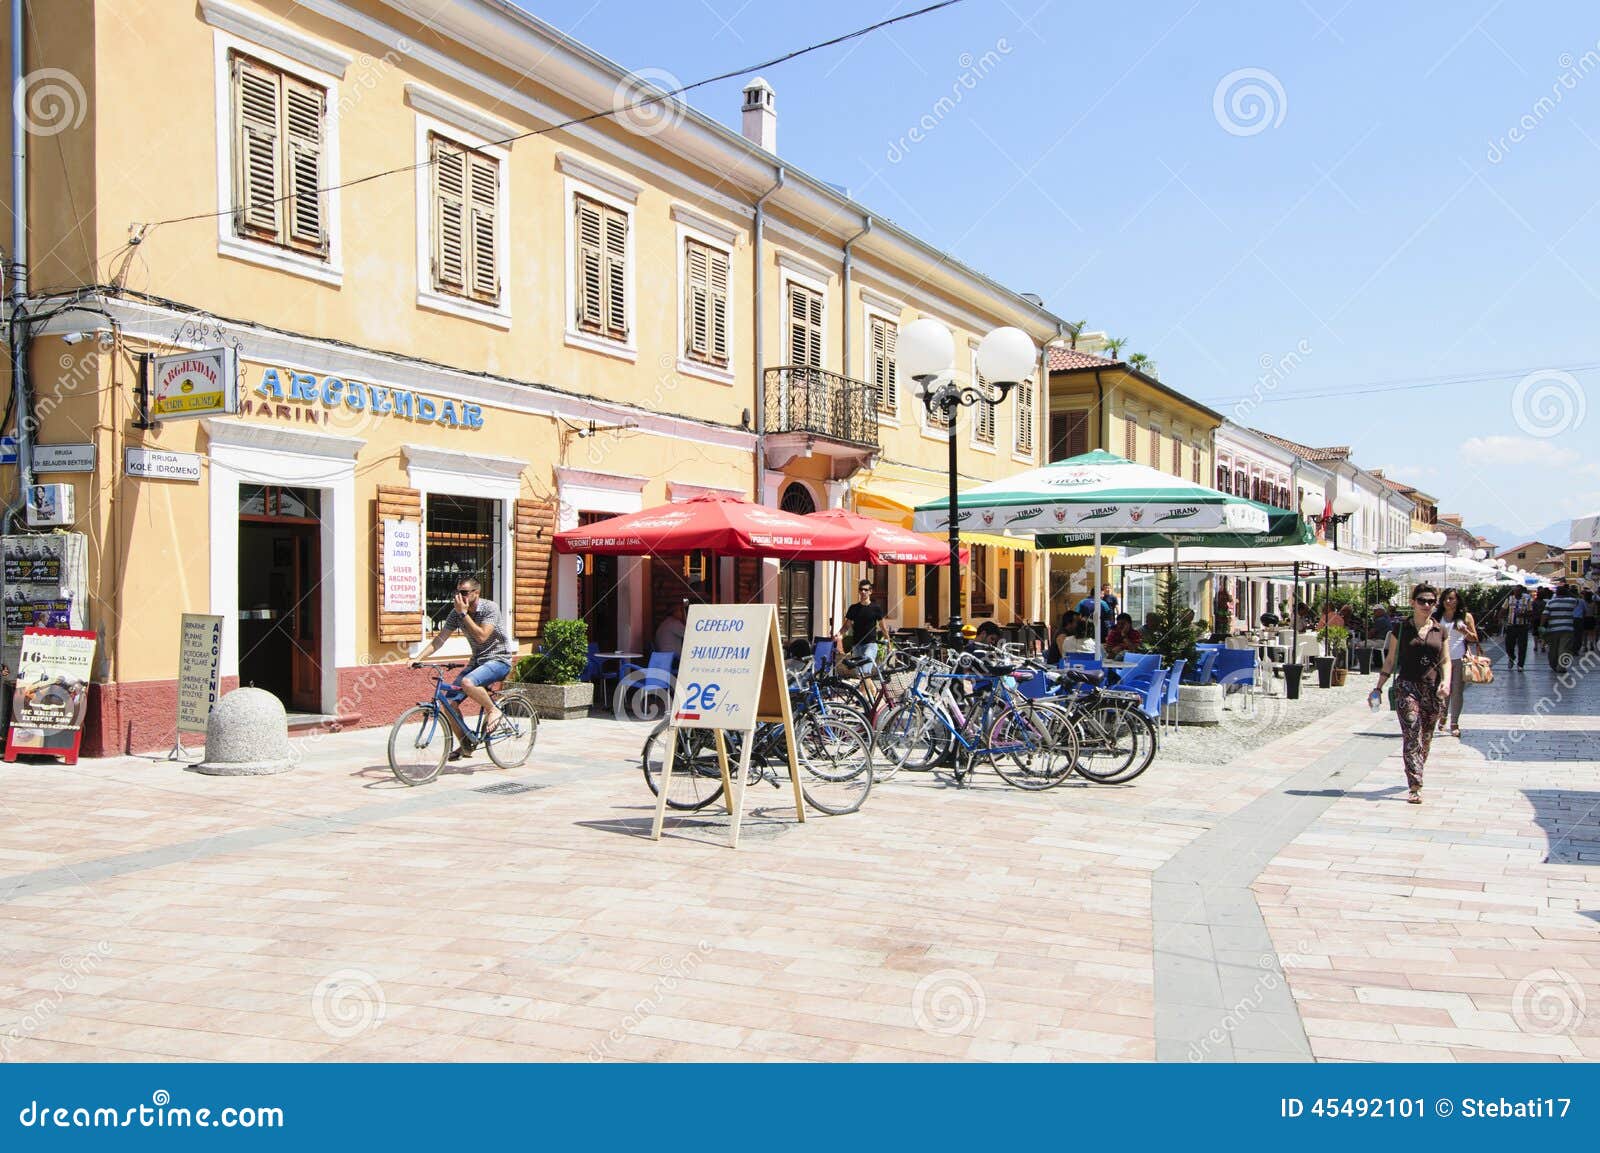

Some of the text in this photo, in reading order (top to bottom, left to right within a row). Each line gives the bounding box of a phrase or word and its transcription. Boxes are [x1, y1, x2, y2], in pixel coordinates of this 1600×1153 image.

[162, 360, 217, 391] ARGJENDAR
[254, 367, 484, 431] ARGJENDAR
[151, 454, 178, 463] RRUGA
[156, 463, 199, 476] IDROMENO
[1016, 507, 1044, 518] TIRANA
[1090, 506, 1119, 516] TIRANA
[1168, 506, 1199, 516] TIRANA
[591, 538, 602, 546] PER
[604, 538, 616, 546] NOI
[695, 619, 744, 632] СЕРЕБРО
[23, 651, 41, 663] 16
[208, 623, 219, 713] ARGJENDA
